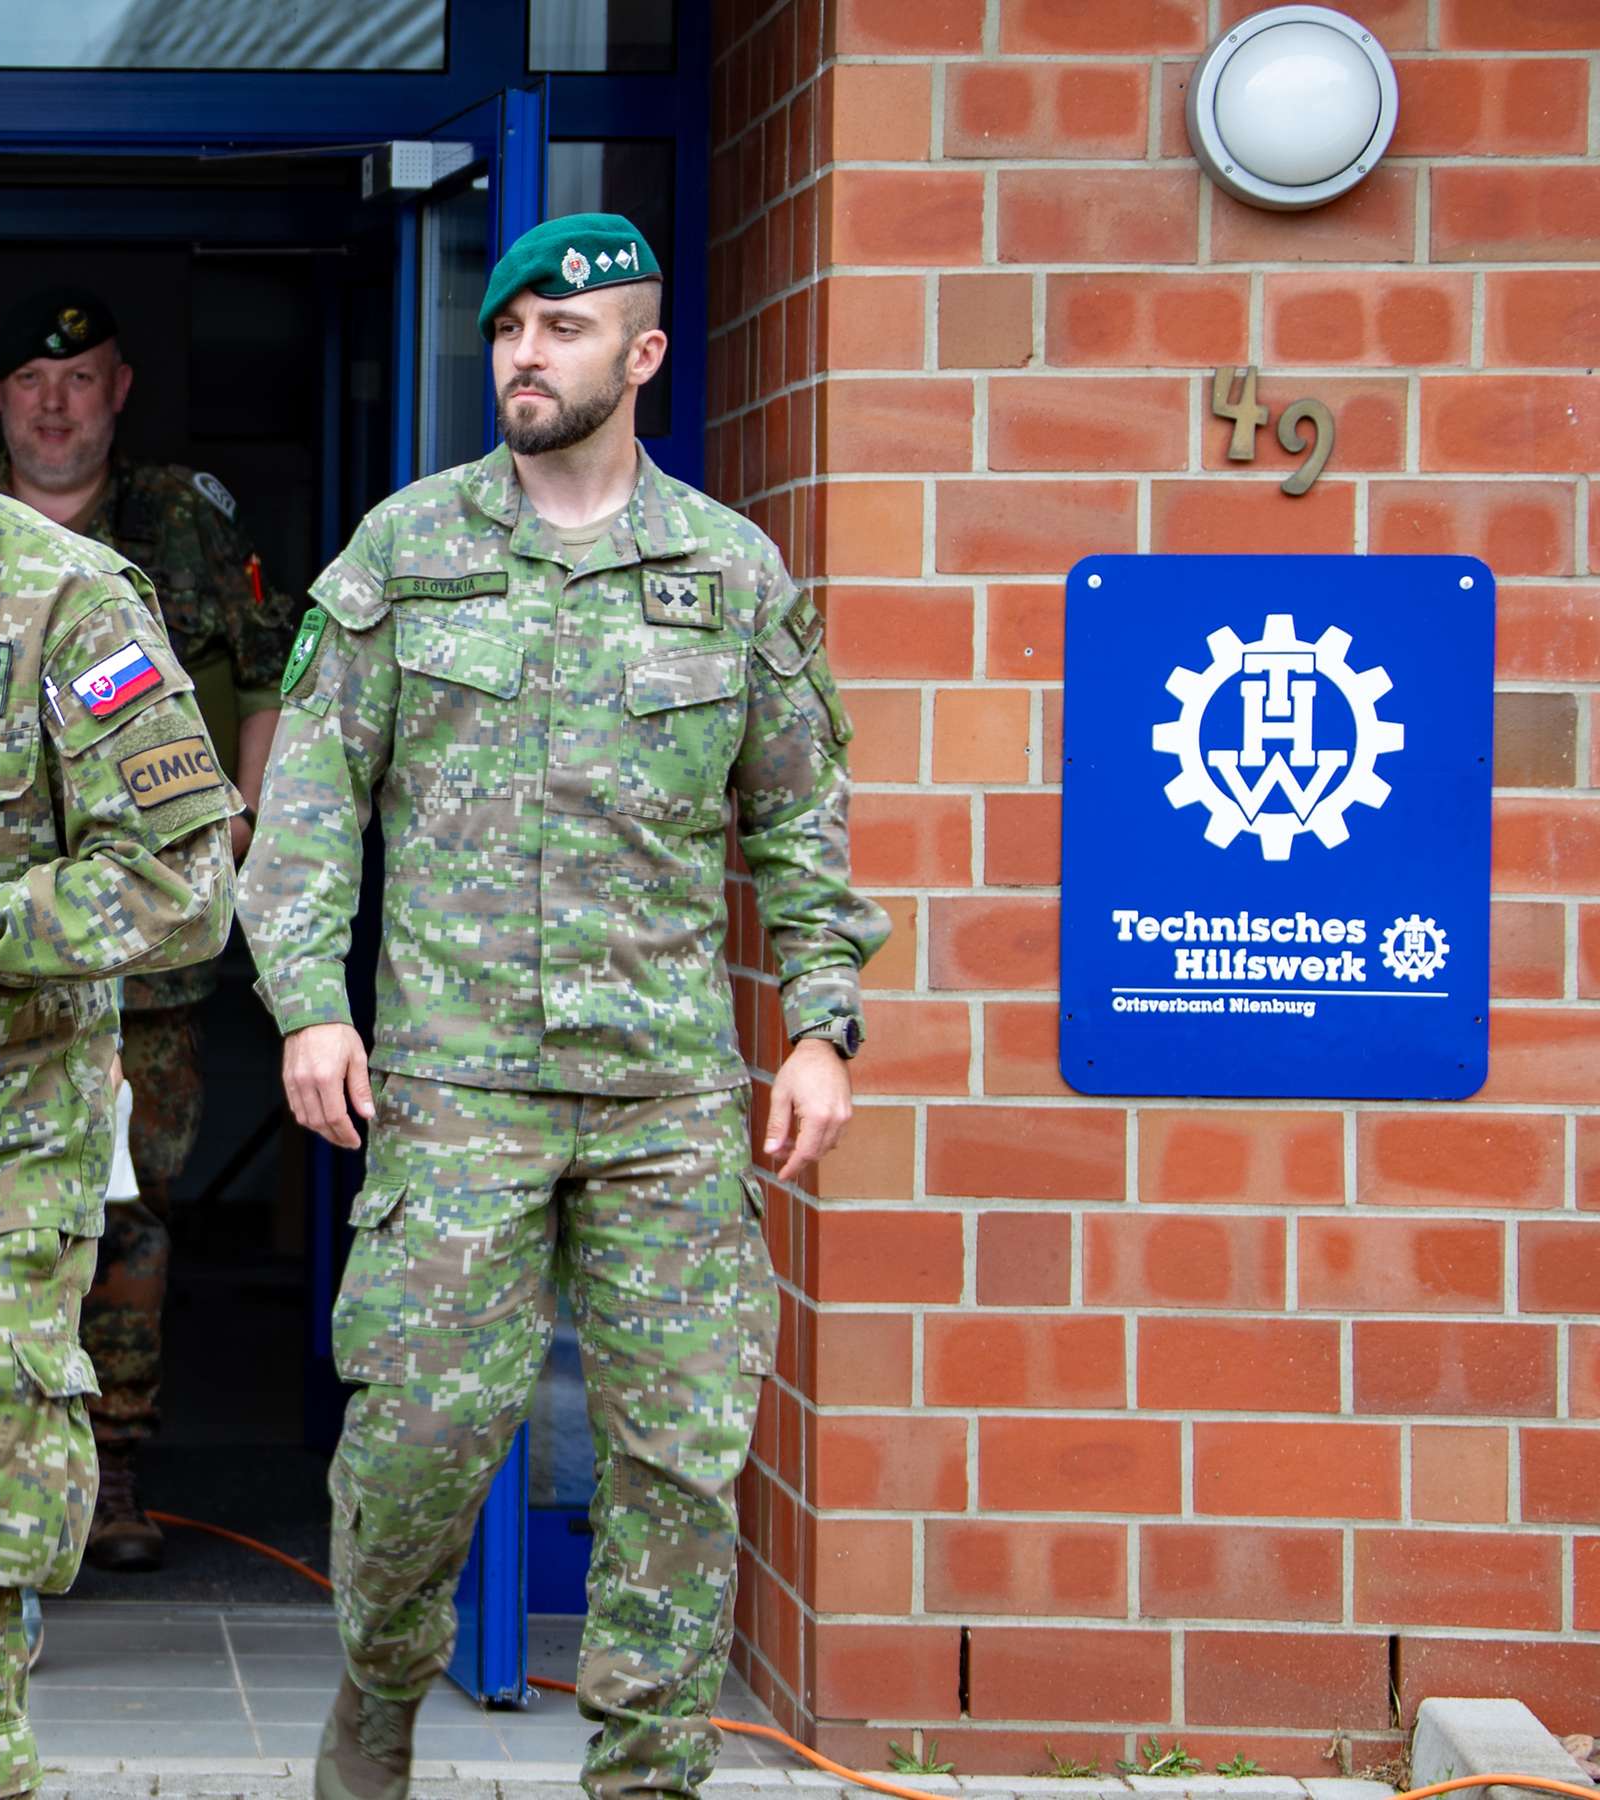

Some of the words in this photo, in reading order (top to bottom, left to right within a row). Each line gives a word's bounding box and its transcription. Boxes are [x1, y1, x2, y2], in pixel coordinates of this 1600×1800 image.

[1212, 366, 1335, 495] 49
[412, 579, 476, 595] SLOVAKIA
[1208, 653, 1348, 822] THW
[129, 751, 214, 793] CIMIC
[1112, 909, 1367, 944] Technisches
[1174, 948, 1367, 982] Hilfswerk
[1112, 996, 1225, 1013] Ortsverband
[1229, 998, 1316, 1018] Nienburg
